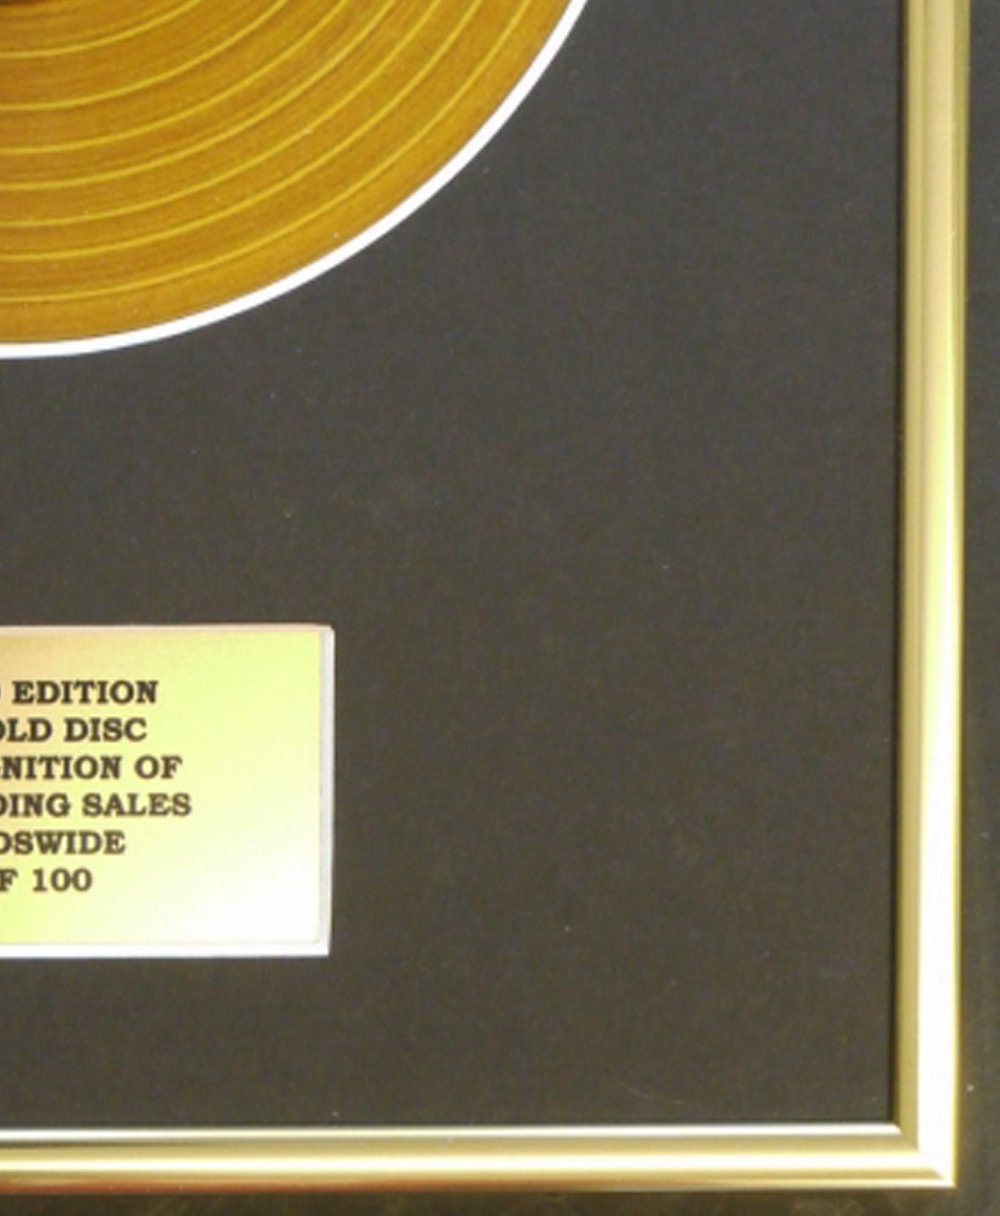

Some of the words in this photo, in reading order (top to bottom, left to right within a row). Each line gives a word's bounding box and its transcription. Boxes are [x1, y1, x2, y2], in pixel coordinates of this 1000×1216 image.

[12, 681, 158, 705] EDITION
[64, 718, 148, 742] DISC
[134, 756, 183, 779] OF
[83, 793, 191, 817] SALES
[32, 868, 93, 892] 100
